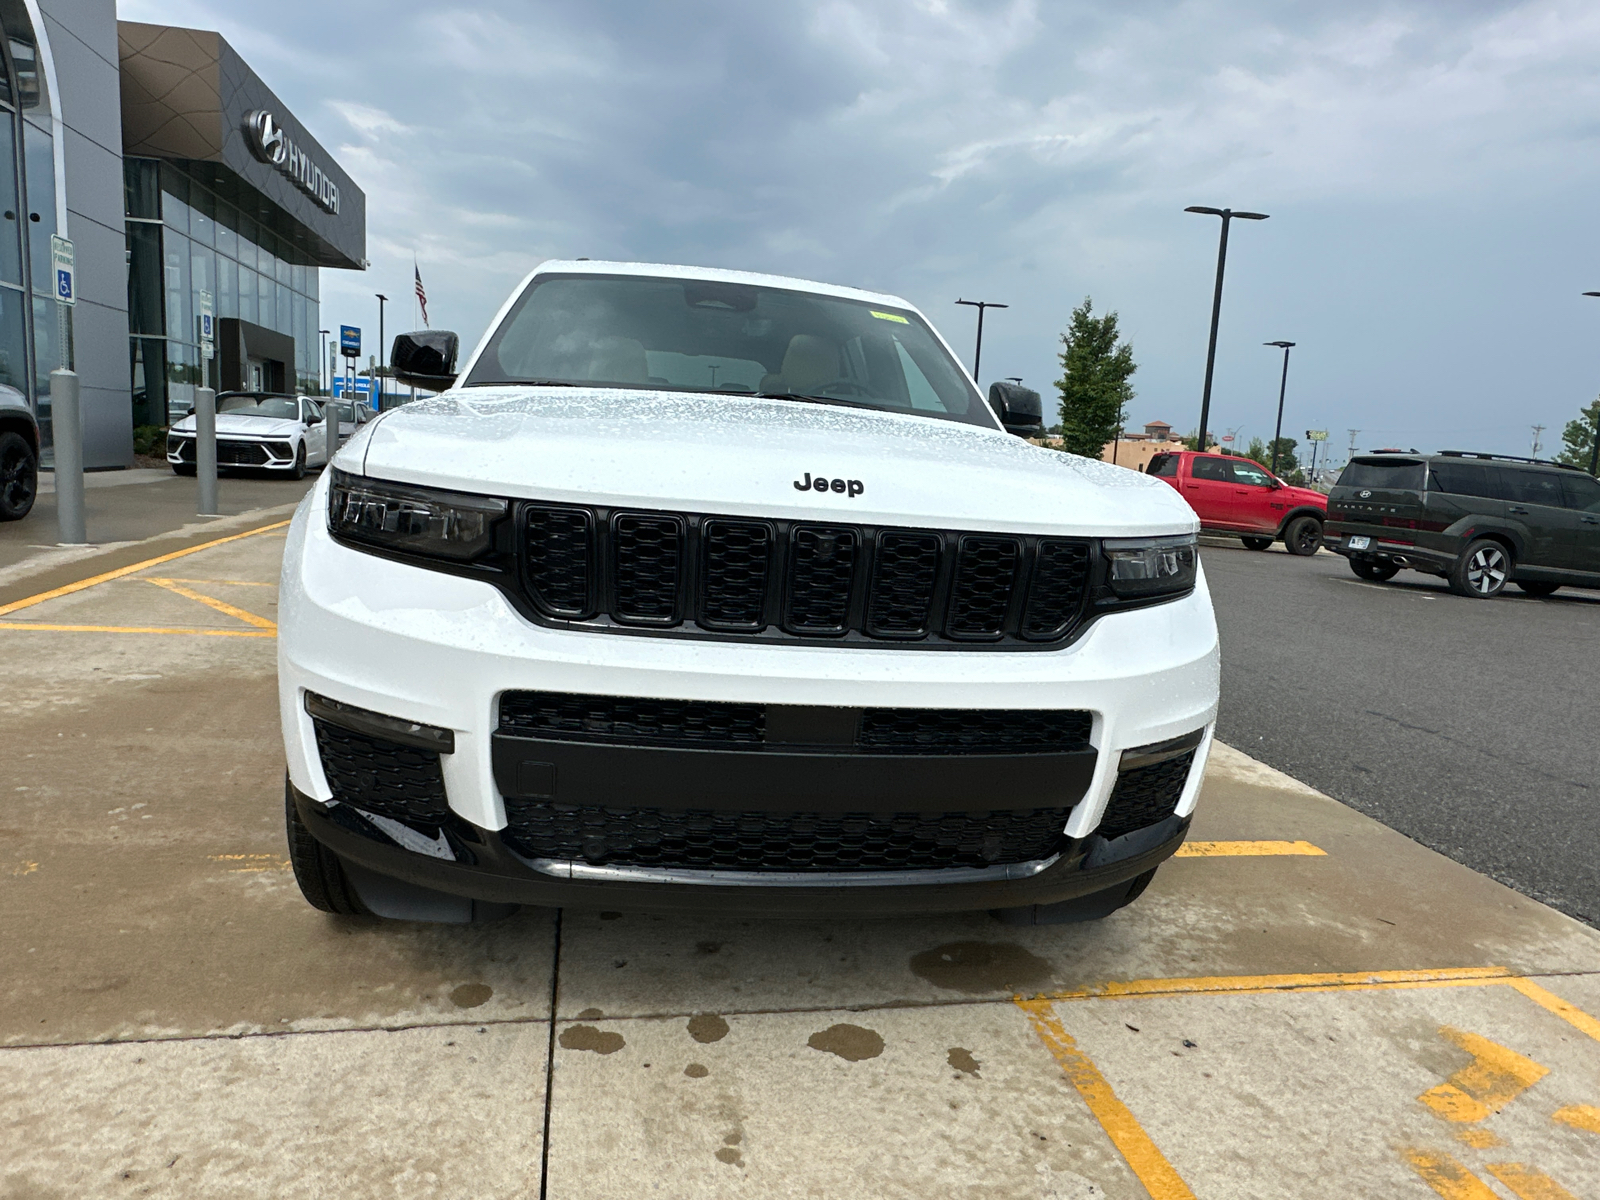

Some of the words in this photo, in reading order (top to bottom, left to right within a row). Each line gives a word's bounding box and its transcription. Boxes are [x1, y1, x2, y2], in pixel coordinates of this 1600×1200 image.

[287, 137, 340, 216] HYUNDAI
[54, 252, 73, 266] PARKING
[793, 472, 865, 498] Jeep
[1336, 503, 1373, 511] SANTA
